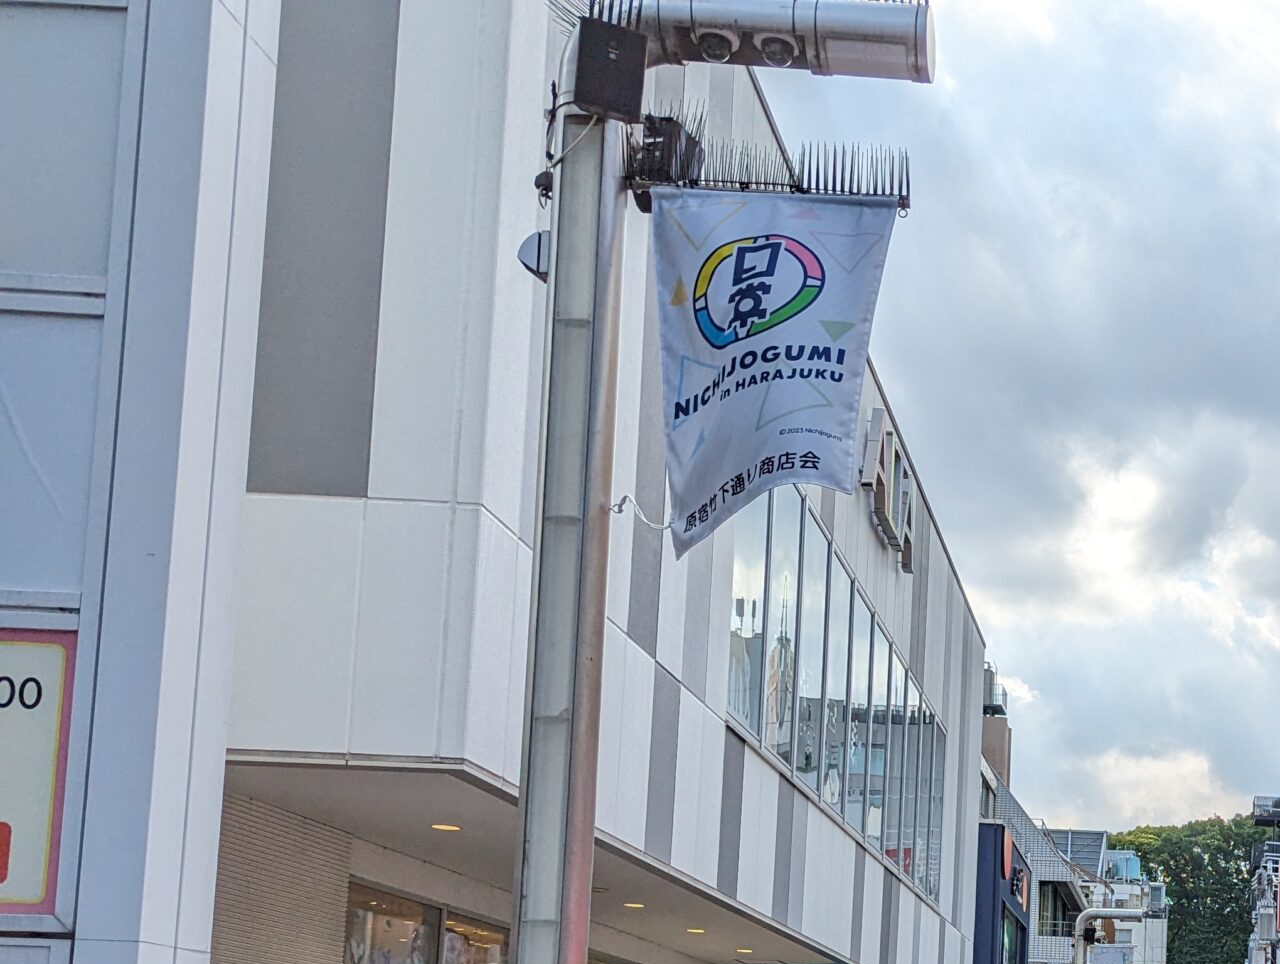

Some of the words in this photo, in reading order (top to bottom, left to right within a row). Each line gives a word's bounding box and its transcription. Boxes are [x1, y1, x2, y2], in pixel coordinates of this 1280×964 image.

[674, 344, 846, 420] NICHIJOGUMI
[719, 388, 731, 401] in
[735, 367, 844, 393] HARAJUKU
[805, 428, 842, 442] Nichijogumi
[683, 450, 821, 533] 原宿竹下通り商店会
